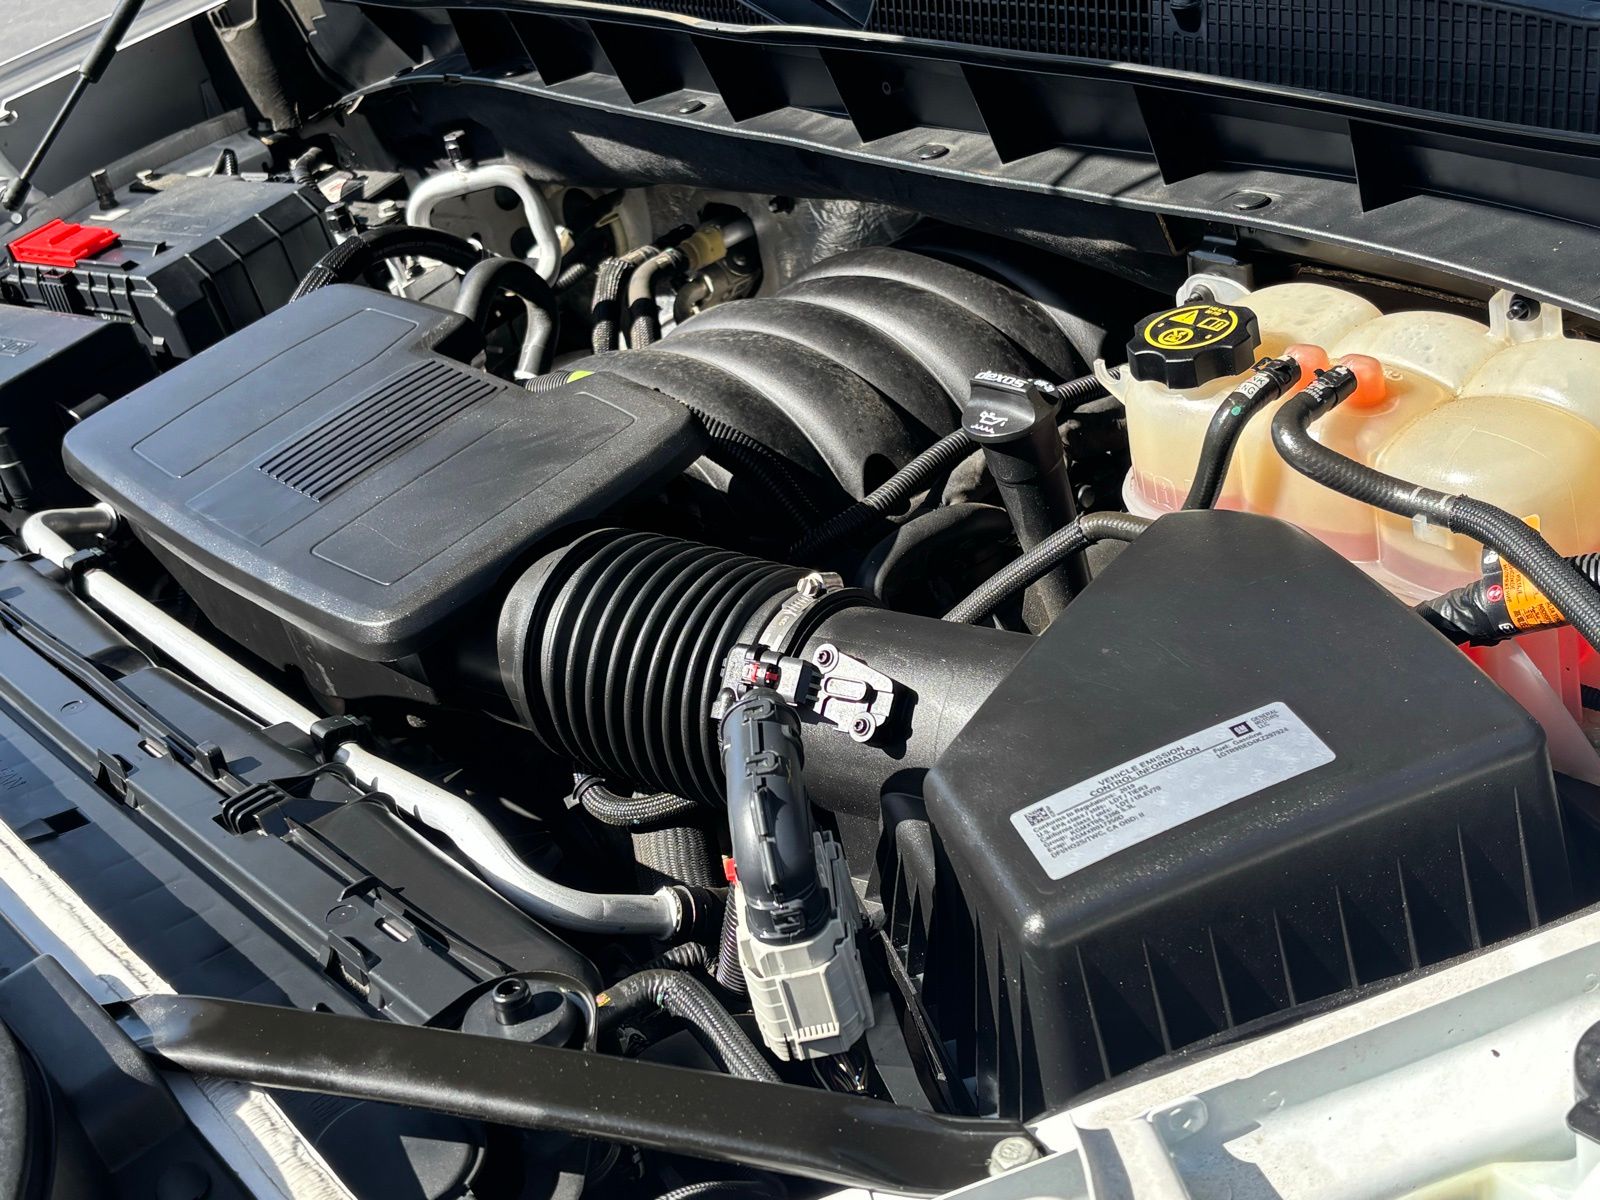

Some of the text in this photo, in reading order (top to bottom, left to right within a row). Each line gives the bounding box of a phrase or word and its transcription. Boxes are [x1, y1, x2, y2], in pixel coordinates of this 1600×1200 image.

[974, 370, 1027, 388] dexos
[1232, 731, 1262, 745] Gasoline
[1089, 746, 1201, 796] CONTROL INFORMATION
[1098, 746, 1185, 785] VEHICLE EMISSION
[1032, 815, 1066, 832] Conforms
[1119, 784, 1135, 793] 2019
[1039, 825, 1073, 842] California
